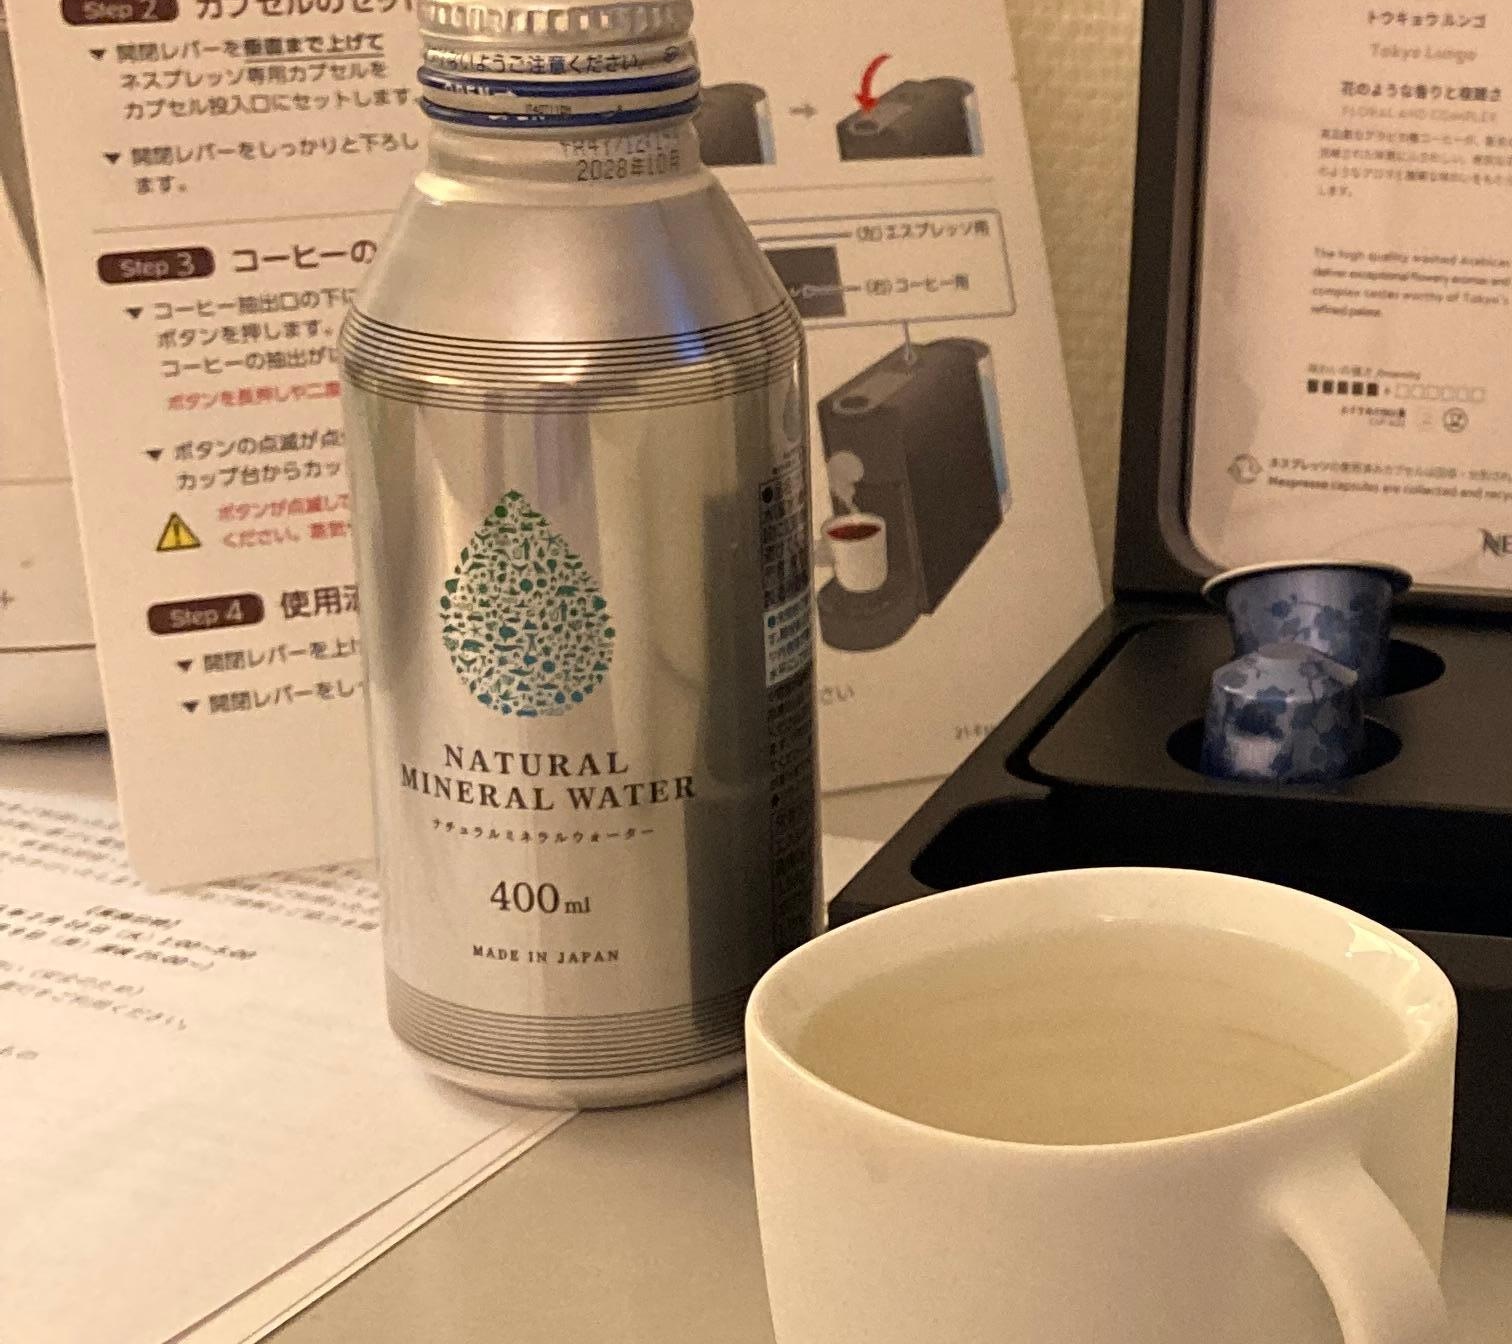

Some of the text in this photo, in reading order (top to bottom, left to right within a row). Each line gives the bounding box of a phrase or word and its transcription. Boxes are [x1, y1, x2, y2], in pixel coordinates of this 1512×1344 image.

[1370, 42, 1421, 62] Tokyo
[135, 175, 189, 195] ます。
[119, 257, 169, 280] Step
[176, 251, 196, 277] 3
[174, 428, 345, 462] ボタンの点滅が点
[224, 599, 245, 623] 4
[203, 637, 360, 673] 開閉レバーを上
[207, 679, 366, 716] 開閉レバーをし
[443, 743, 630, 778] NATURAL
[400, 762, 697, 811] MINERAL WATER
[431, 817, 655, 845] ナチュラルミネラルウォーター
[489, 881, 593, 916] 400ml
[472, 944, 620, 965] MADE IN JAPAN
